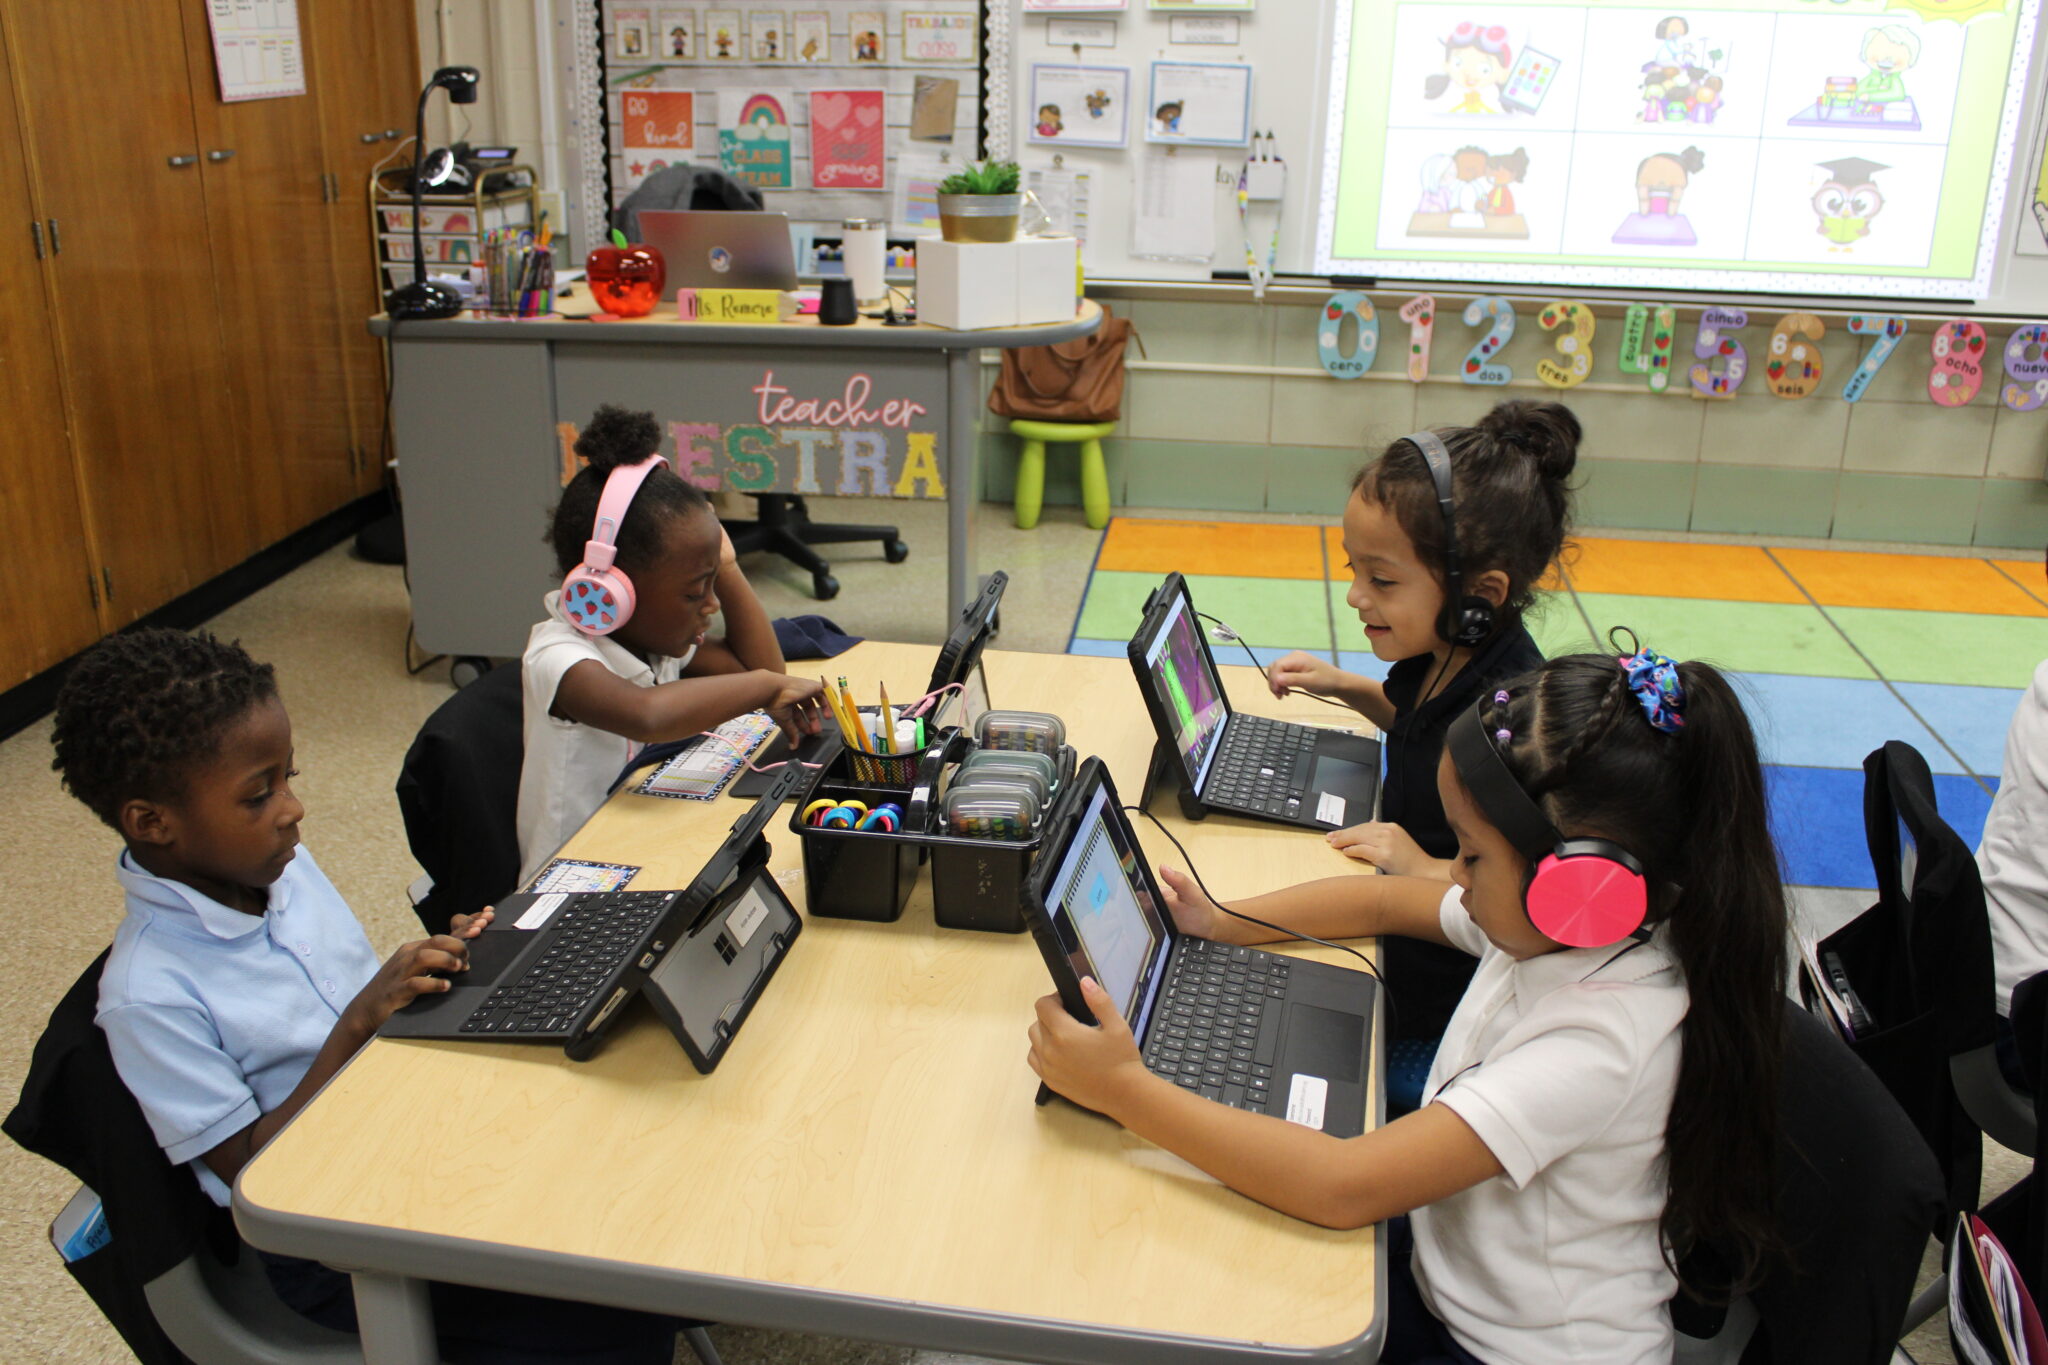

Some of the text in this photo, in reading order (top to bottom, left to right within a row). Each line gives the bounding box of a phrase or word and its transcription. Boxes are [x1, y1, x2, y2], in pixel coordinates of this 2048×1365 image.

[1318, 291, 1379, 380] 0
[1400, 292, 1436, 383] 1
[1406, 298, 1431, 318] uno
[1461, 296, 1514, 386] 2
[1537, 300, 1597, 390] 3
[1625, 310, 1643, 362] cuatro
[1705, 312, 1744, 325] cinco
[1329, 362, 1363, 372] cero
[1479, 369, 1504, 381] dos
[1541, 364, 1568, 383] tres
[1619, 303, 1677, 394] 4
[1689, 307, 1749, 397] 5
[1766, 312, 1825, 400] 6
[1842, 316, 1909, 403] 7
[1845, 372, 1867, 398] siete
[1928, 319, 1988, 408] 8
[1945, 357, 1978, 375] ocho
[2002, 324, 2048, 412] 9
[752, 370, 928, 429] teacher
[1777, 384, 1804, 395] seis
[556, 420, 948, 499] MESTRA
